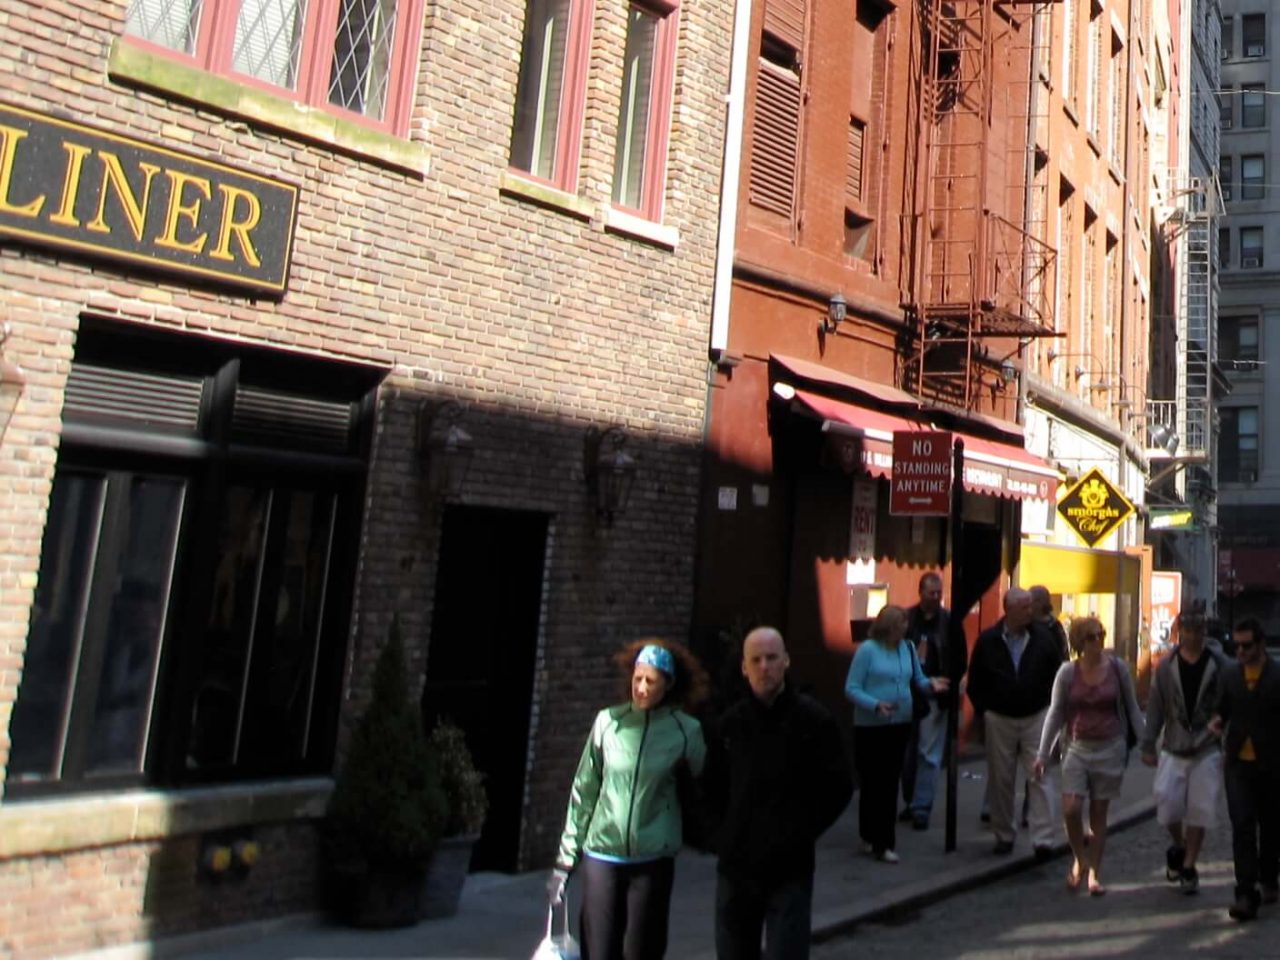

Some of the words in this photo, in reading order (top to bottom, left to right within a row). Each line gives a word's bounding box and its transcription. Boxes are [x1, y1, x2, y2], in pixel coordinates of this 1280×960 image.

[912, 440, 932, 456] NO
[894, 461, 949, 476] STANDING
[896, 479, 945, 493] ANYTIME
[1076, 516, 1109, 536] Chef
